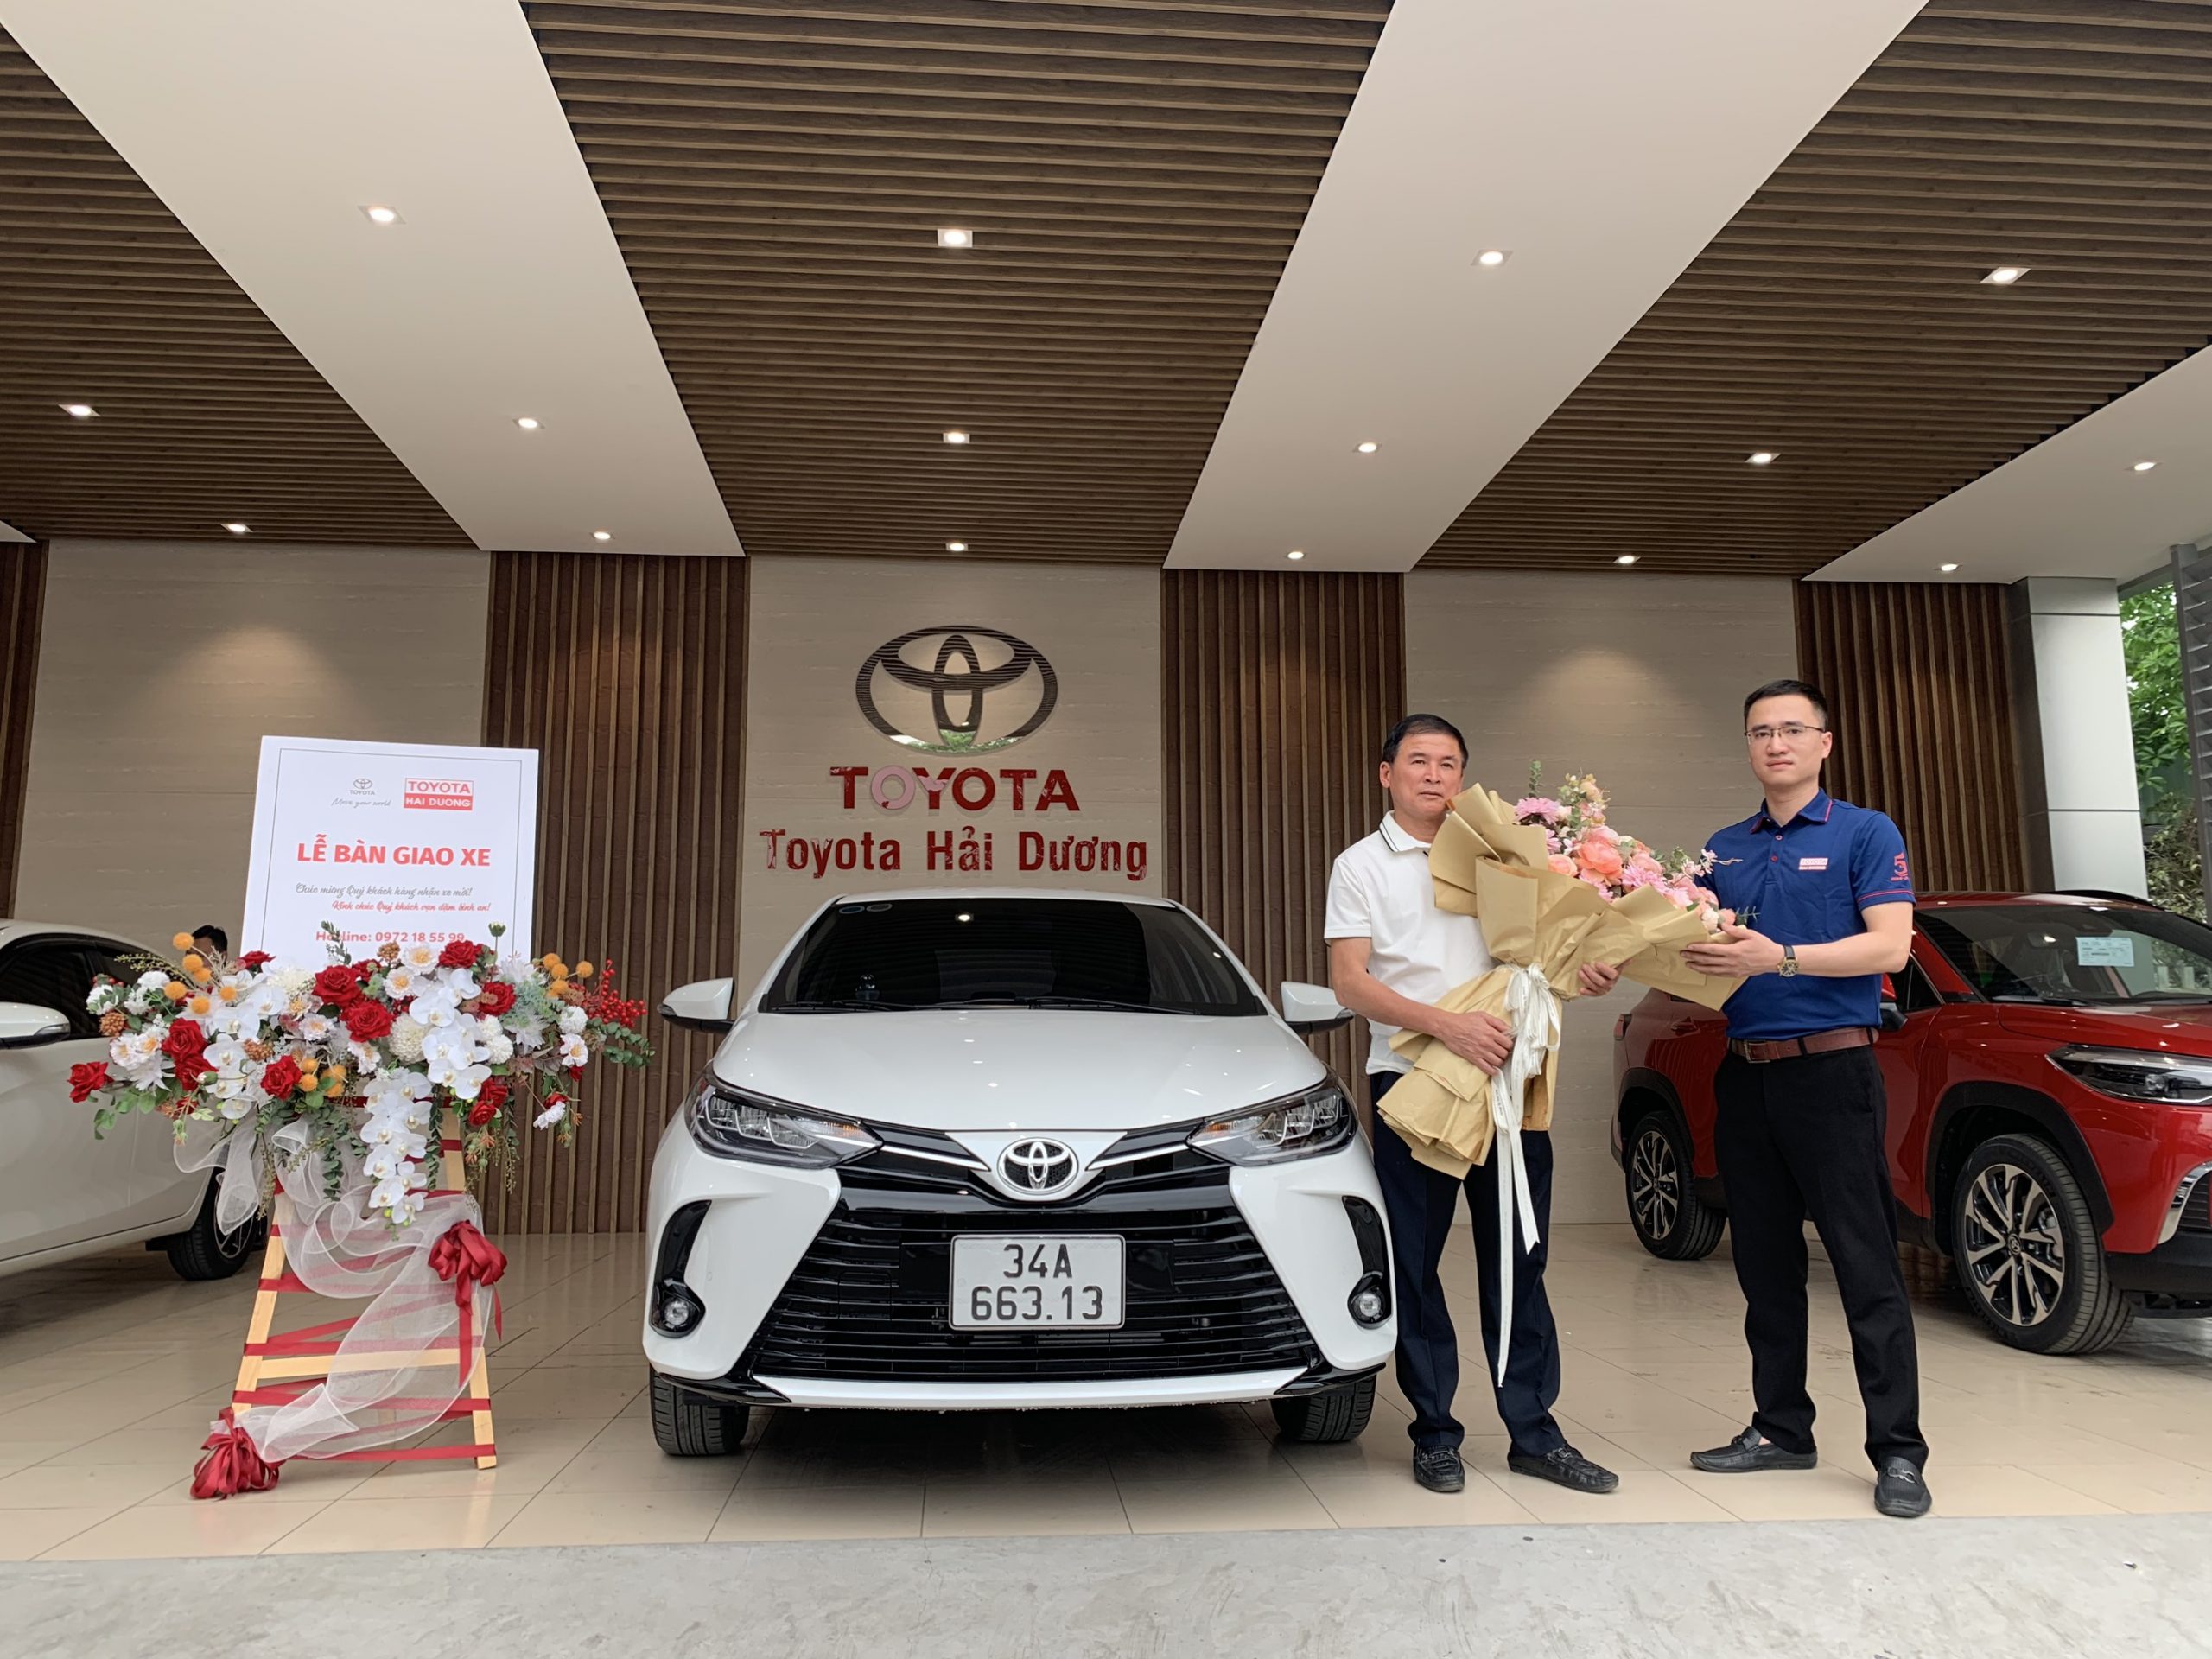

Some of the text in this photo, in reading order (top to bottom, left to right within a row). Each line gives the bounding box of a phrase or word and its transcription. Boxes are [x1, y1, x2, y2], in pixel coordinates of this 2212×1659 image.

[405, 797, 471, 808] HAI DUONG
[407, 780, 471, 794] TOYOTA
[830, 766, 1081, 812] TOYOTA
[297, 834, 492, 867] LỄ BÀN GIAO XE
[760, 826, 1147, 881] Toyota Hải Dương
[346, 884, 365, 899] Quý
[366, 885, 393, 895] khách
[394, 887, 417, 899] hàng
[315, 931, 465, 943] Holine: 0972 18 55 99
[1003, 1243, 1073, 1279] 34A
[971, 1285, 1103, 1321] 663.13
